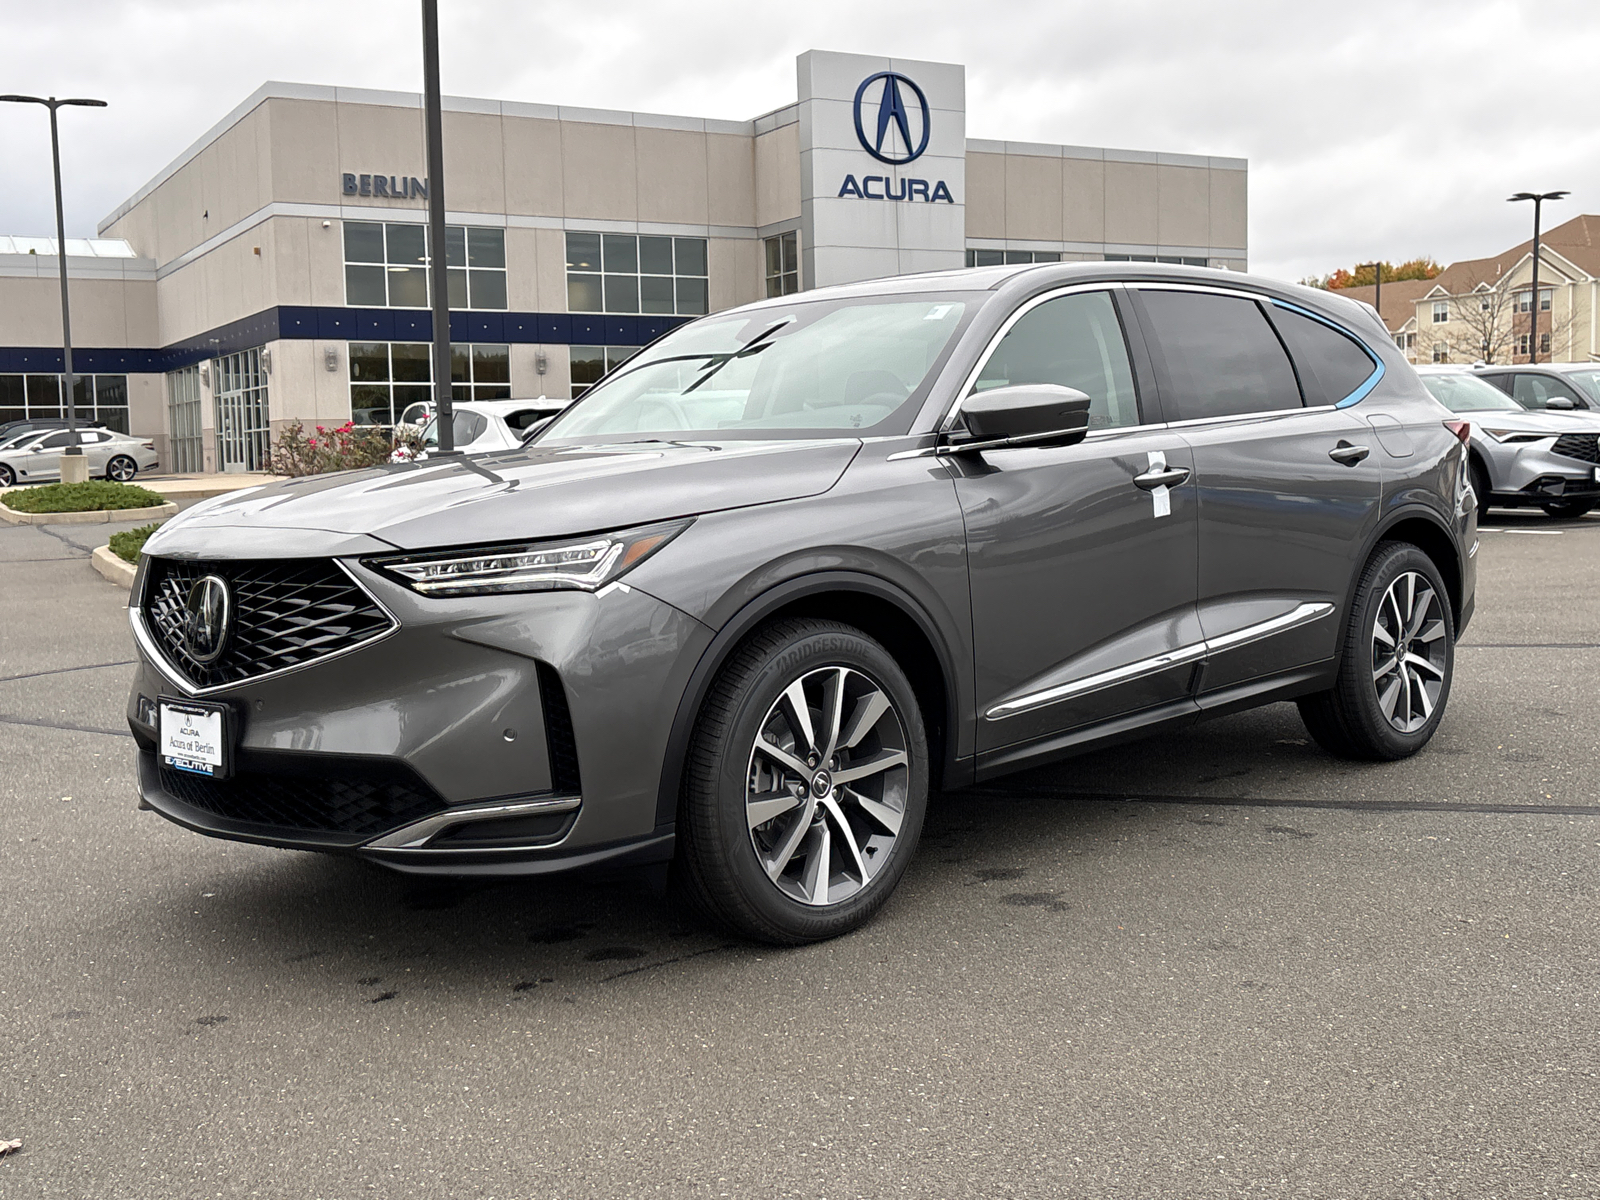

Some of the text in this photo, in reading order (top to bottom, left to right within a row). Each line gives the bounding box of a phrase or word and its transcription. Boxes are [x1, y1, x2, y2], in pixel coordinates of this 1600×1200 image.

[343, 173, 428, 199] BERLIN
[838, 174, 954, 203] ACURA
[777, 637, 871, 676] BRIDGESTONE
[179, 727, 200, 738] ACURA
[169, 735, 215, 756] Acura of Berlin
[165, 756, 213, 773] EXECUTIVE
